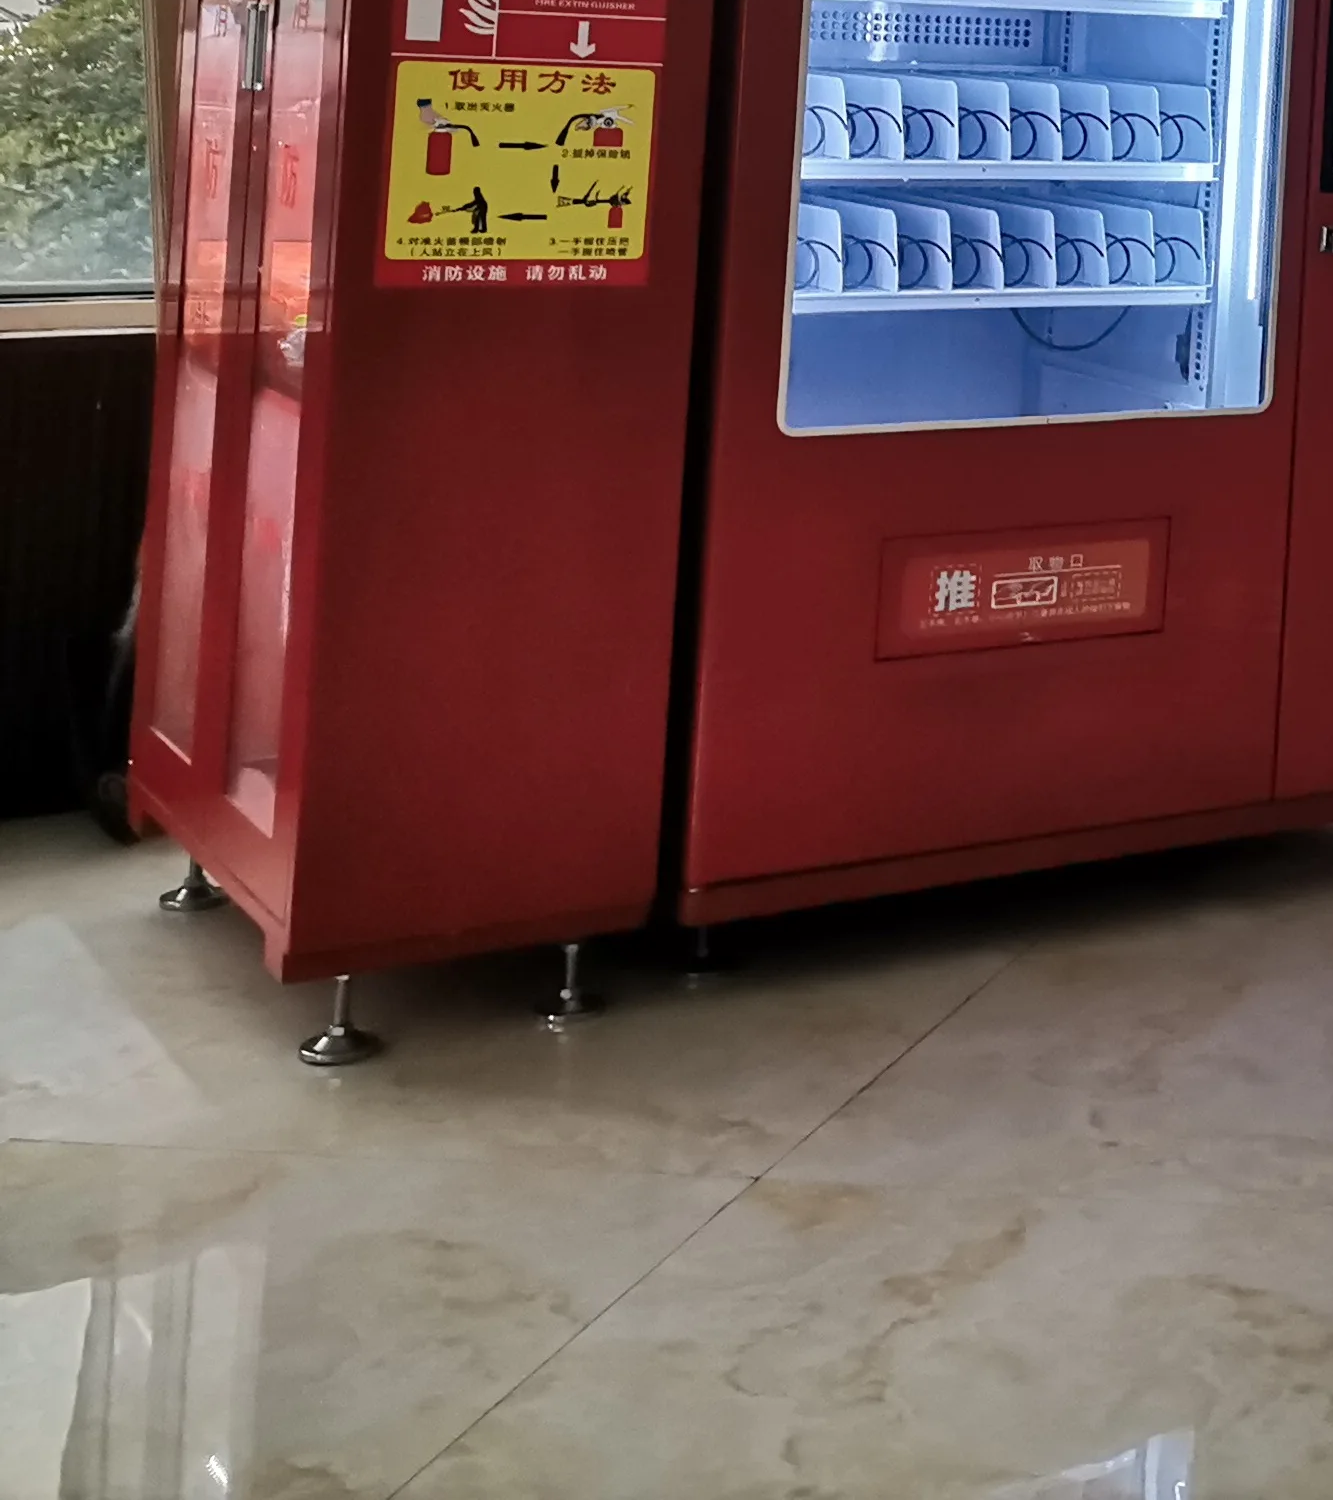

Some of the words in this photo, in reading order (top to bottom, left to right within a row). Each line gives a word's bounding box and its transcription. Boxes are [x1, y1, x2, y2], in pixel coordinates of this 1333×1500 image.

[448, 68, 617, 95] 使用方法
[421, 265, 508, 282] 消防设施
[525, 264, 608, 281] 请勿乱动
[934, 569, 977, 613] 推
